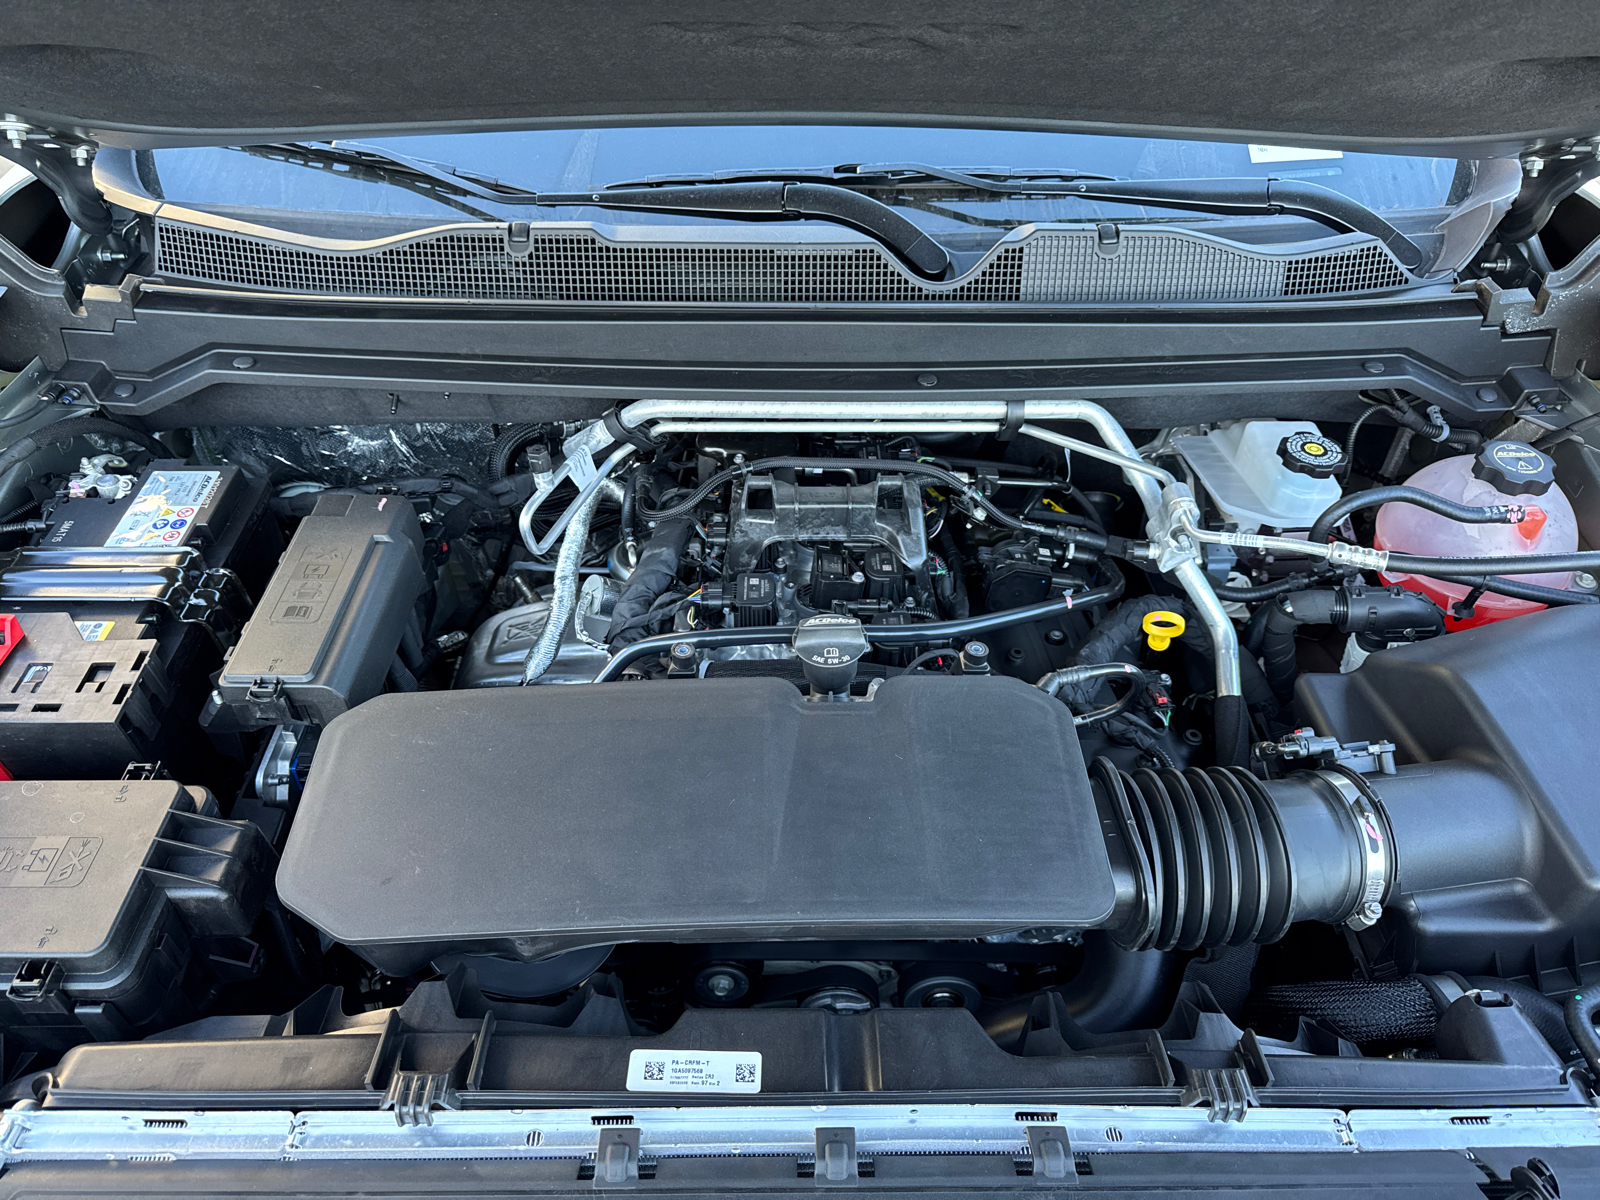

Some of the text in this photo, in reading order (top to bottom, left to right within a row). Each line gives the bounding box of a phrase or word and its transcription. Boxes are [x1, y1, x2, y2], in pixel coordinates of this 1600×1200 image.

[192, 475, 213, 503] ACDelco
[802, 617, 857, 627] ACDelco
[811, 654, 851, 664] SAE 5W-30
